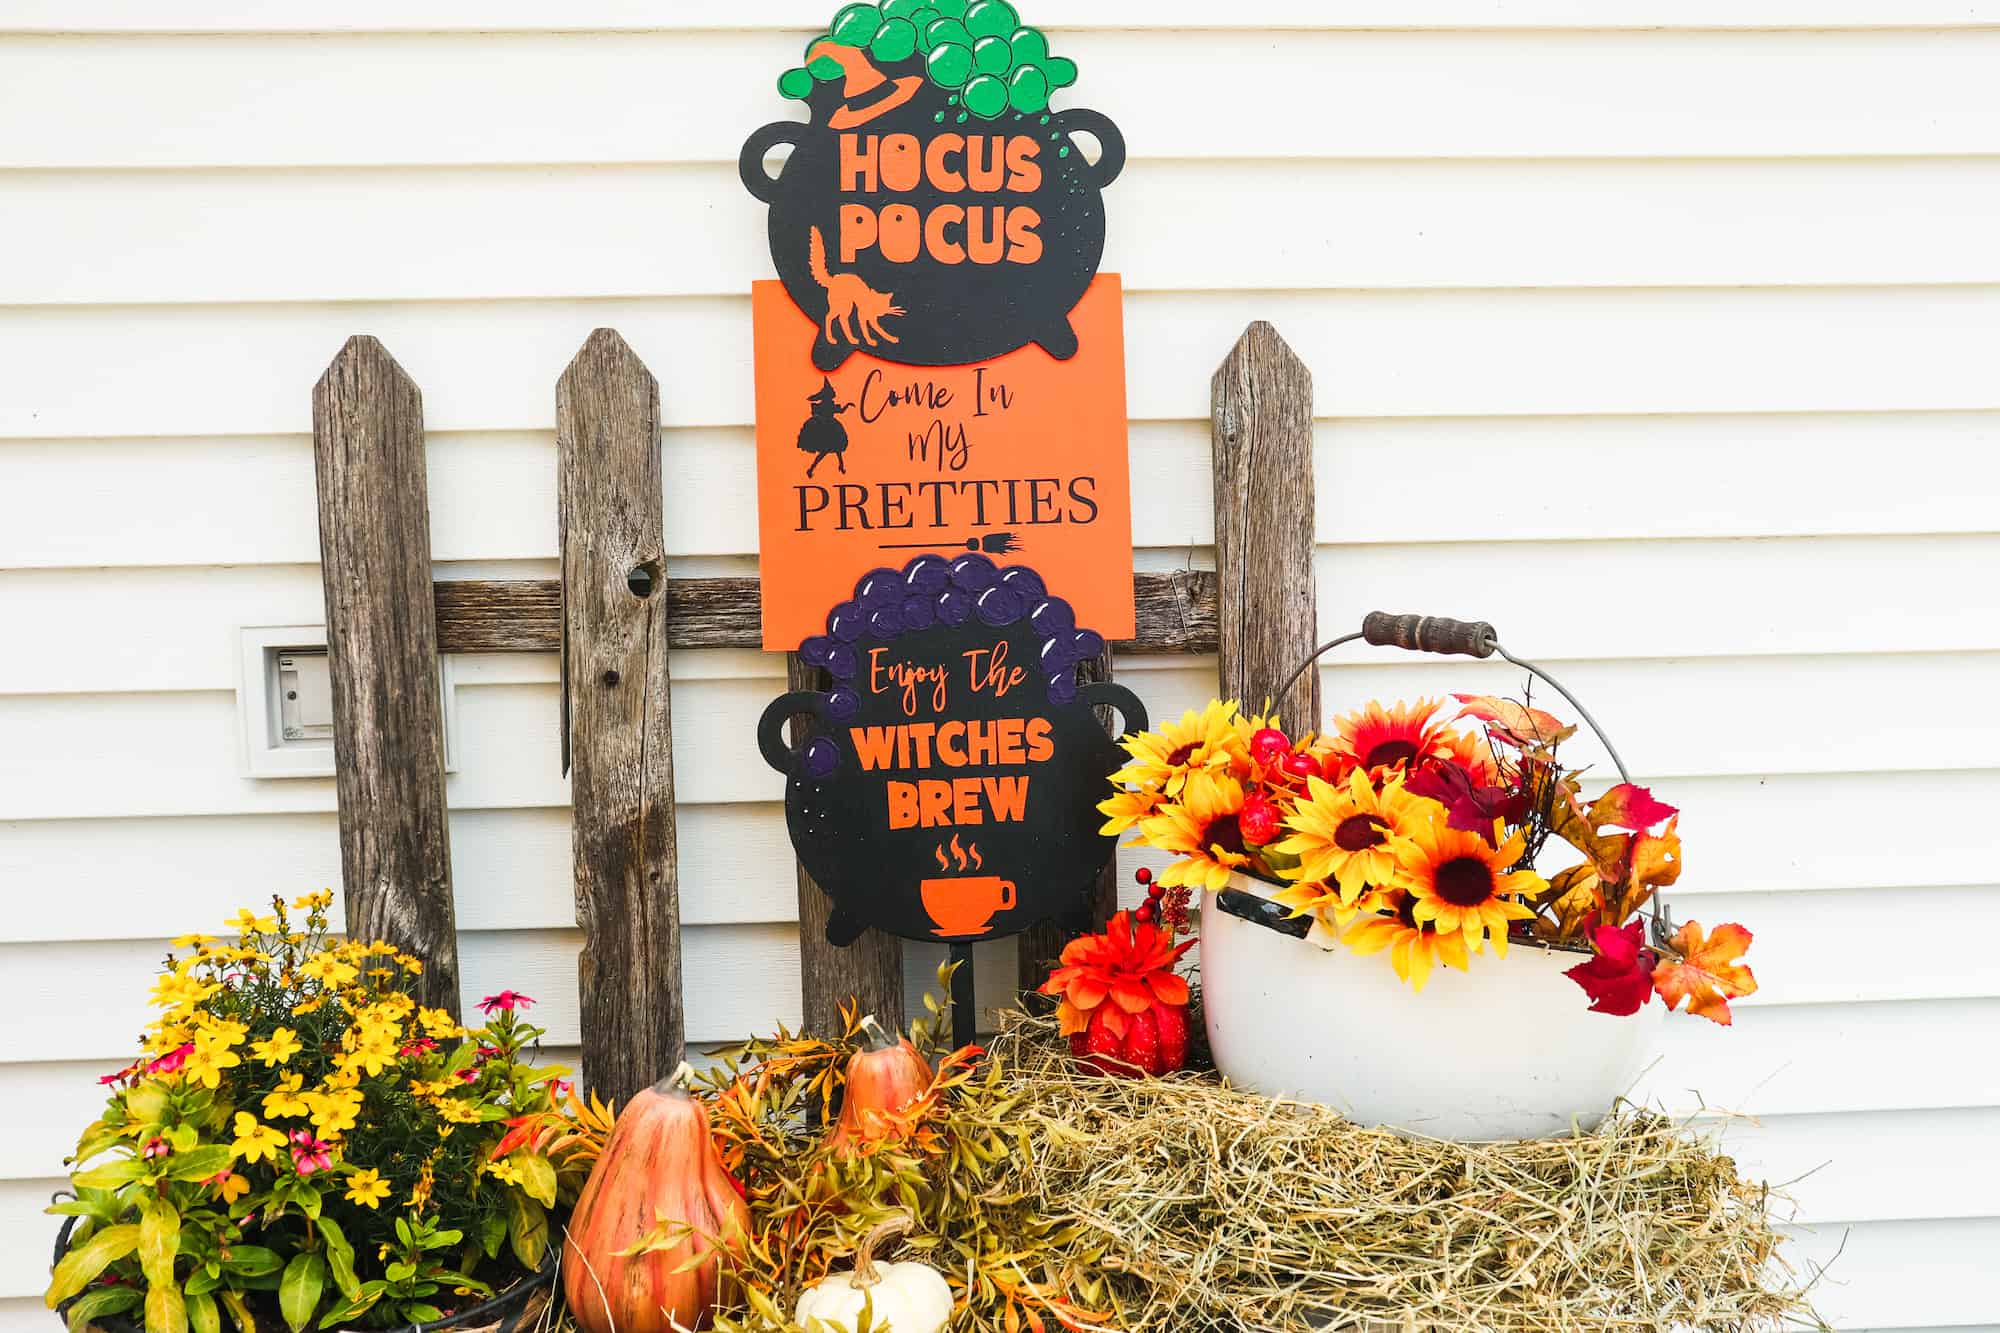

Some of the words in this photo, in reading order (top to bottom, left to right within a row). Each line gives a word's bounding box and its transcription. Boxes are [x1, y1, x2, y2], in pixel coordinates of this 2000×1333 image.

[839, 133, 1042, 193] HOCUS
[839, 203, 1043, 264] POCUS
[859, 368, 954, 423] Come
[972, 367, 1014, 417] In
[793, 476, 1098, 532] PRETTIES
[867, 647, 949, 717] Enjoy
[962, 640, 1029, 698] The
[849, 717, 1055, 771] WITCHES
[887, 775, 1030, 830] BREW
